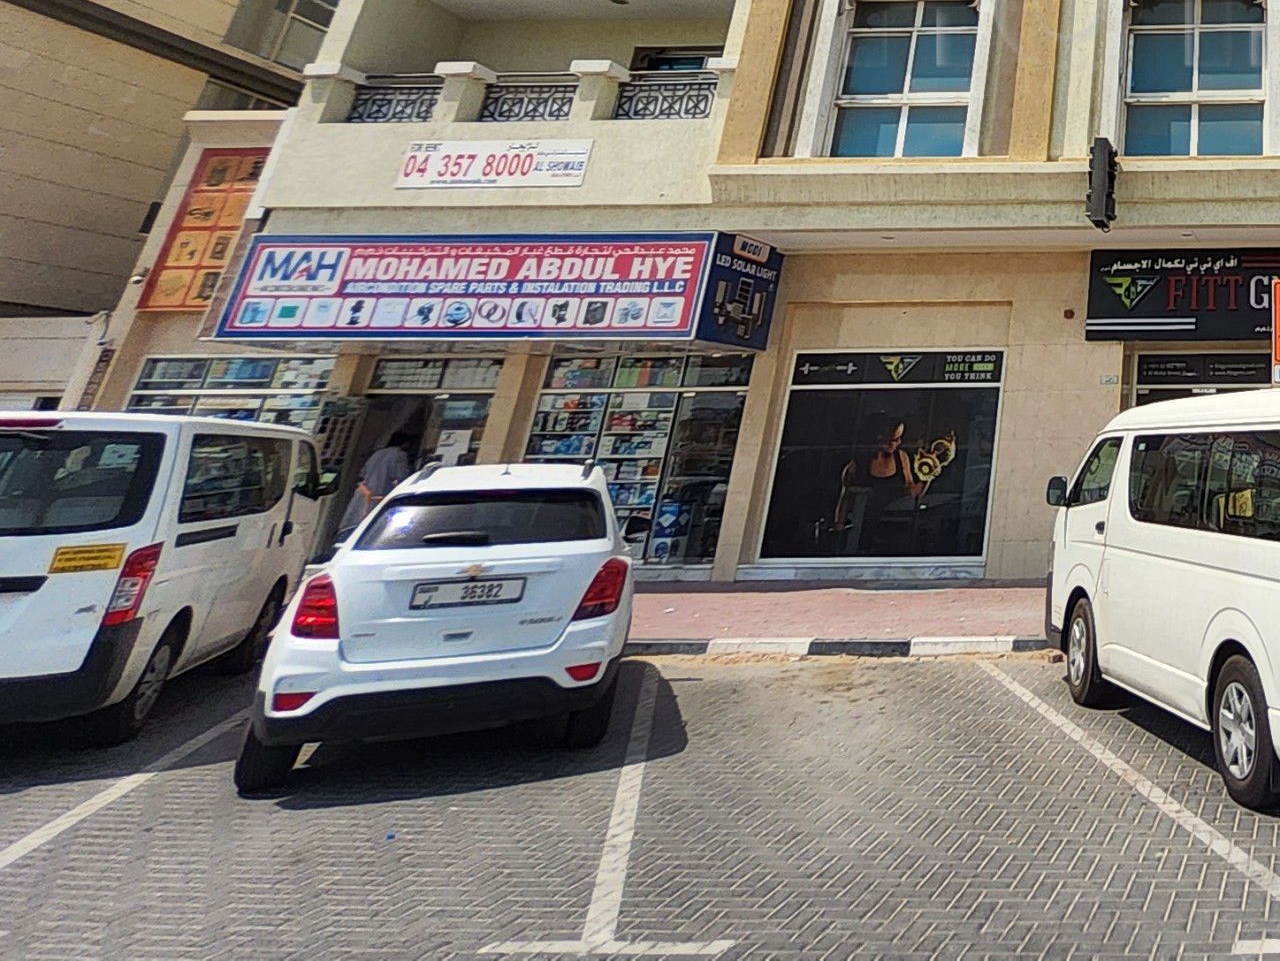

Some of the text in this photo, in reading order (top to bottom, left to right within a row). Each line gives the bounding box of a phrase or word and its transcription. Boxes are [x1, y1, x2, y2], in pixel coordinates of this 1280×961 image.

[404, 153, 534, 178] 04 357 8000
[667, 246, 696, 255] محمد
[257, 251, 345, 282] MAH
[344, 256, 695, 281] MOHAMED ABDUL HYE
[716, 253, 777, 281] LED SOLAR LIGHT
[428, 282, 468, 294] SPARE
[468, 282, 508, 294] PARTS
[509, 282, 519, 294] &
[598, 281, 650, 294] TRADING
[651, 281, 685, 293] L.L.C
[1166, 276, 1244, 311] FITT
[964, 372, 993, 380] THINK
